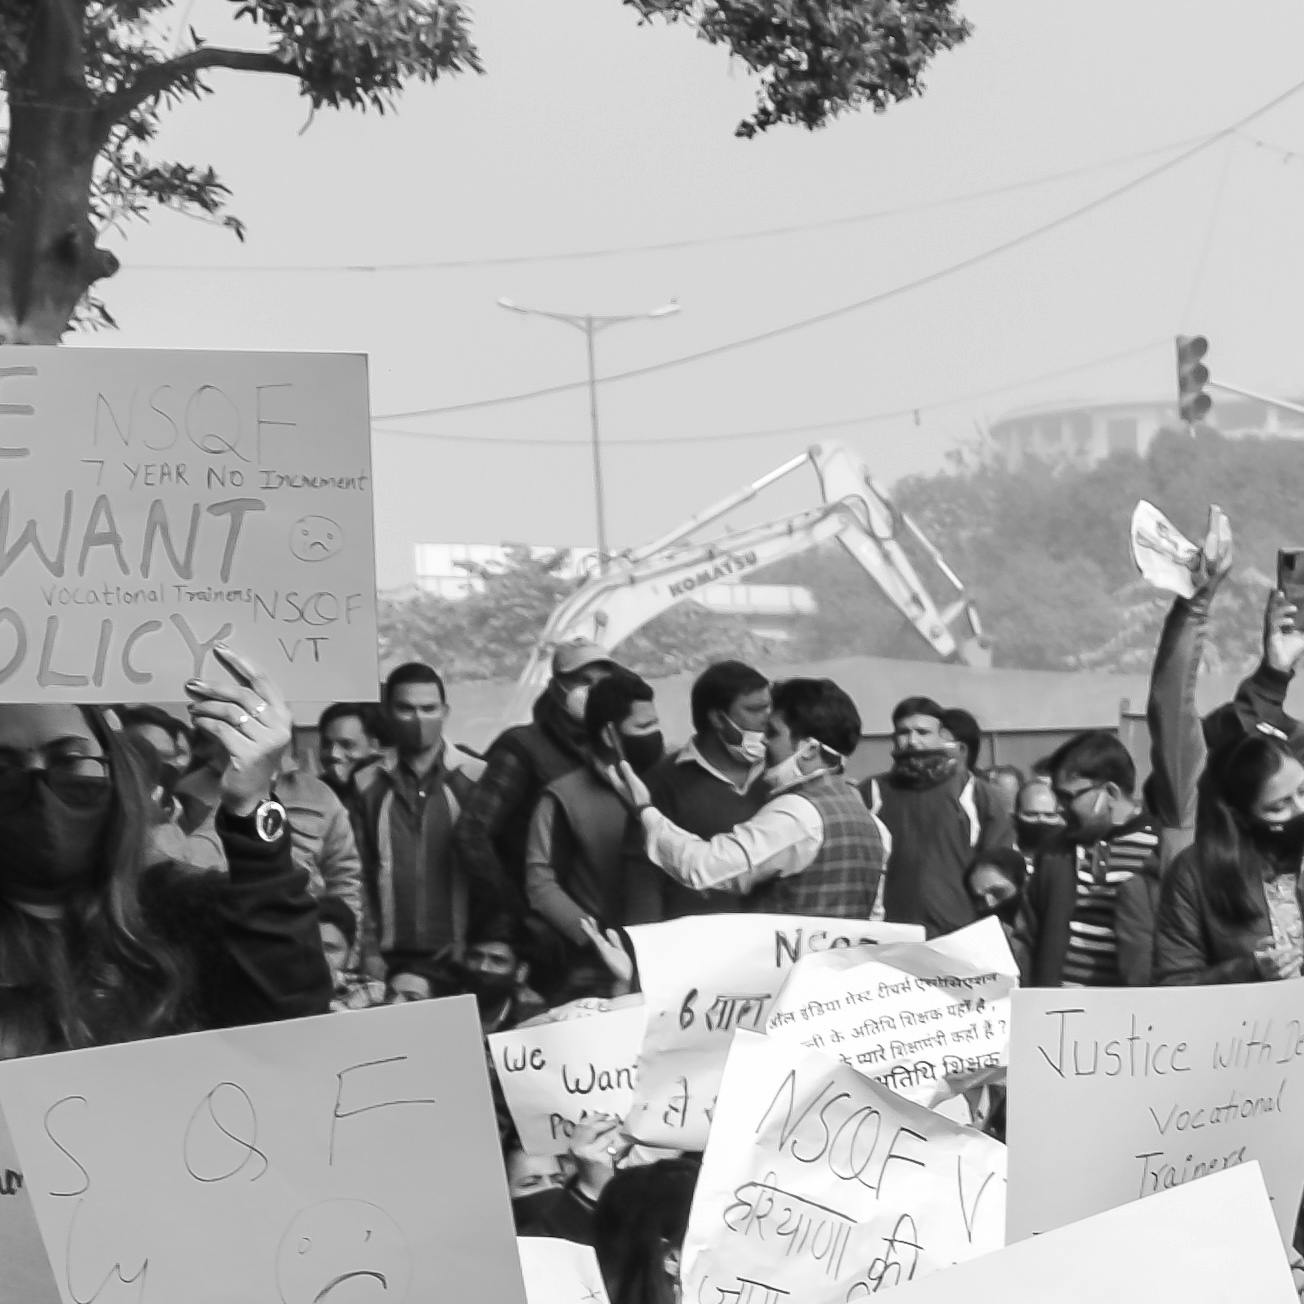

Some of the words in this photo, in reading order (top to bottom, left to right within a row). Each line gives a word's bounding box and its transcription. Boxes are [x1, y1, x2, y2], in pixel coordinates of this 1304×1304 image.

[0, 366, 38, 457] E
[94, 384, 296, 464] NSQF
[123, 462, 190, 490] YEAR
[207, 465, 245, 489] NO
[259, 468, 368, 490] Increment
[669, 551, 758, 598] KOMATSU
[0, 607, 233, 688] OLICY
[278, 637, 329, 663] VT
[851, 1015, 897, 1039] अतिथि
[900, 1011, 943, 1029] शिक्षक
[1038, 1008, 1192, 1078] Justice
[756, 1070, 928, 1200] NSQF
[1149, 1078, 1287, 1135] Vocational
